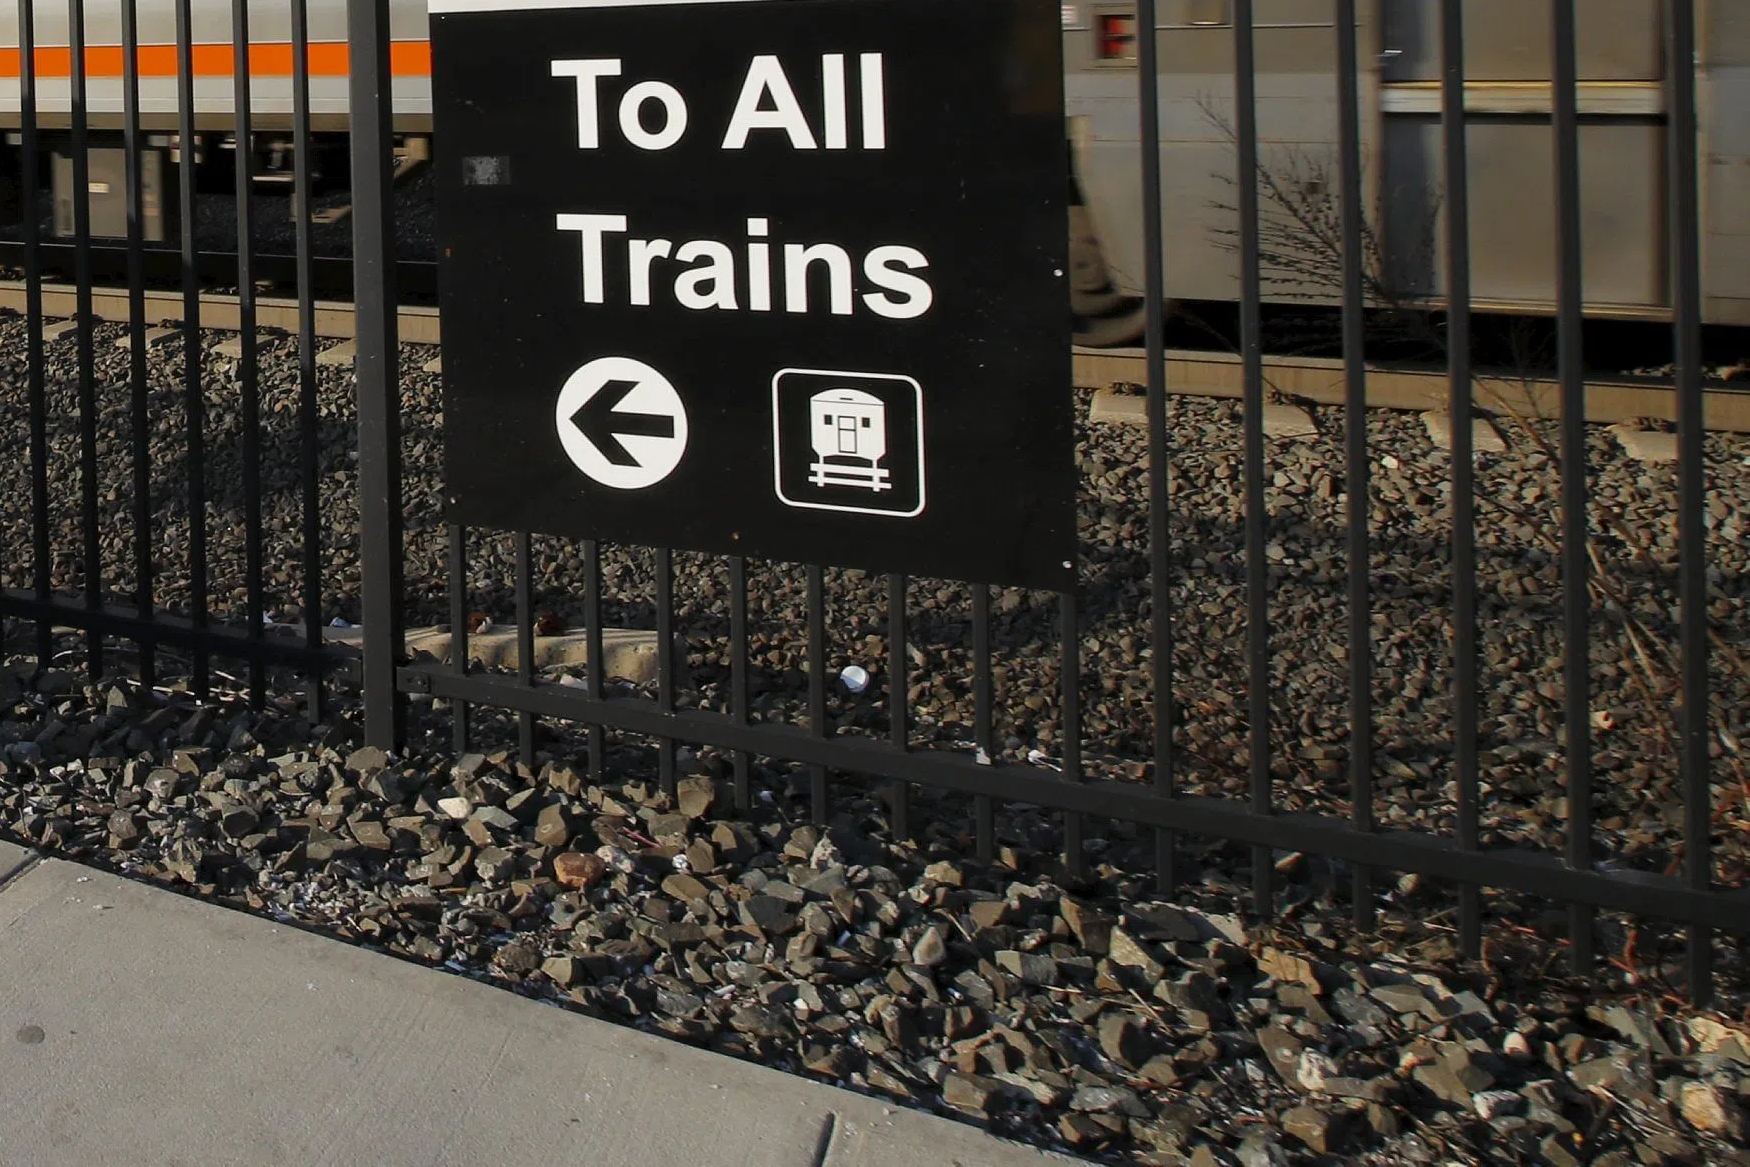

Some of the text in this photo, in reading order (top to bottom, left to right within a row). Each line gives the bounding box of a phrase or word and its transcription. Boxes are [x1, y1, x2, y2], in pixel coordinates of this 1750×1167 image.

[551, 52, 886, 150] To All
[556, 212, 934, 319] Trains
